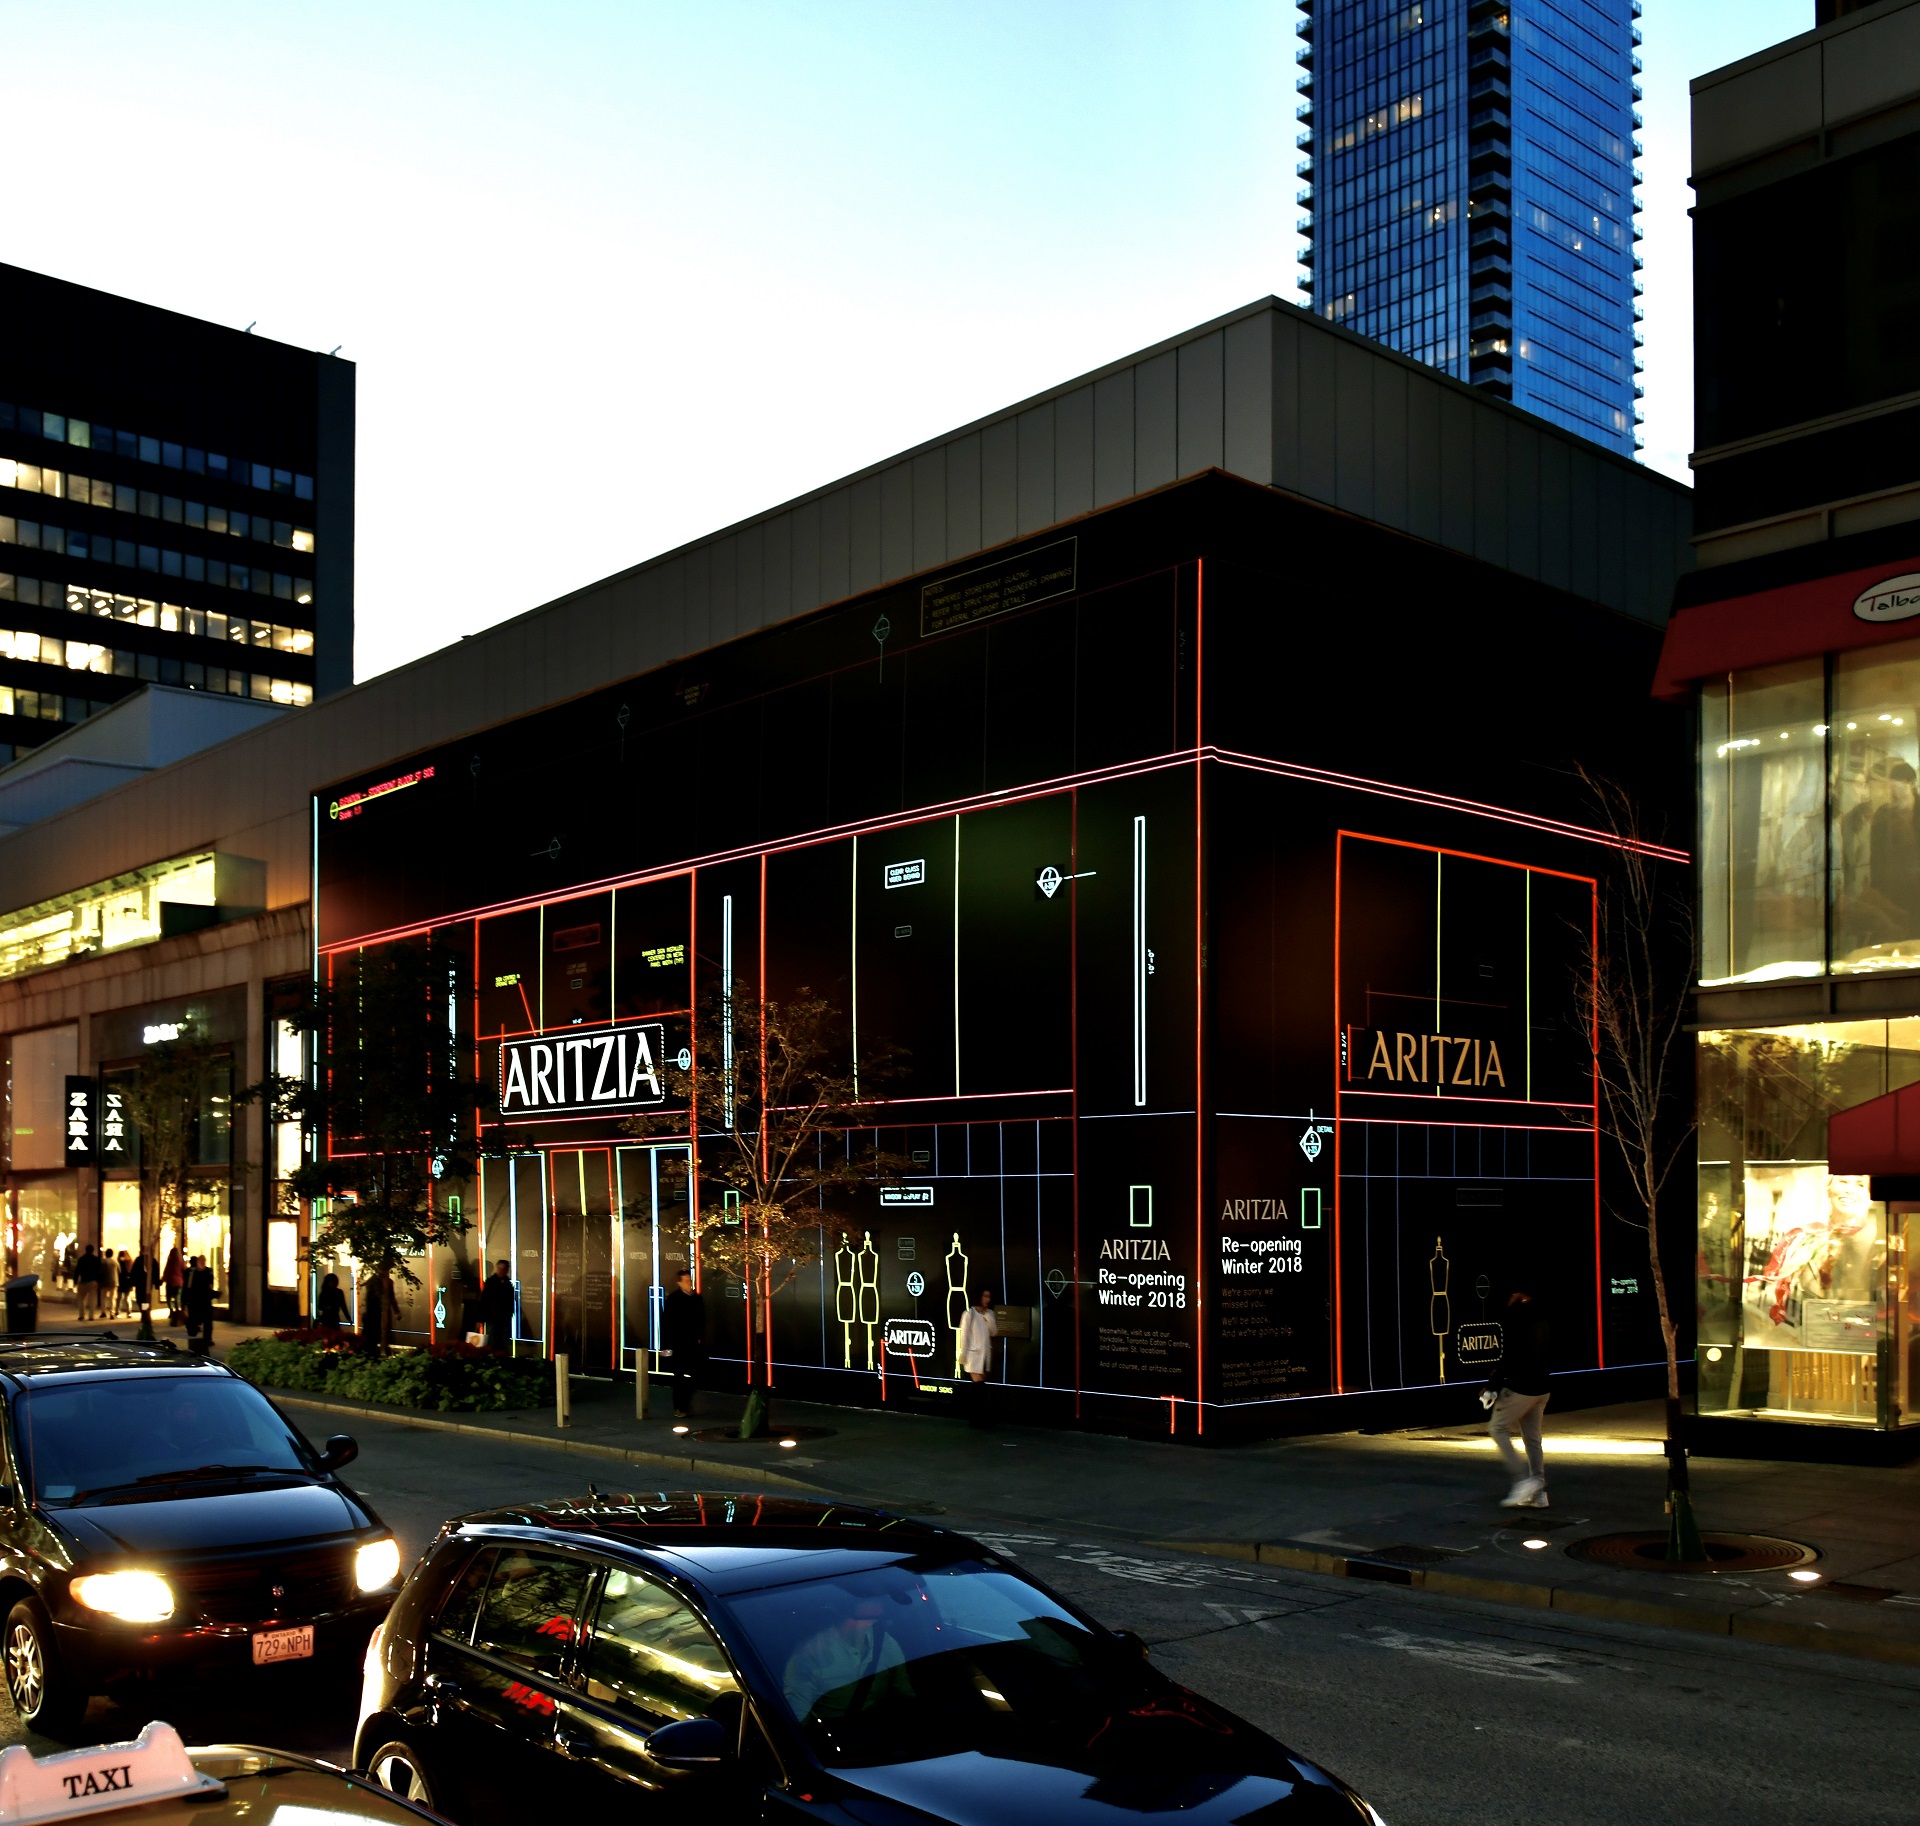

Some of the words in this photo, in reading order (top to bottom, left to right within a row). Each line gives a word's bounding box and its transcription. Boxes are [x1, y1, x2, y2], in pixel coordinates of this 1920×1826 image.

[1367, 1030, 1506, 1088] ARITZIA
[503, 1032, 661, 1108] ARITZIA
[68, 1092, 89, 1151] ZARA
[1221, 1199, 1288, 1220] ARITZIA
[1099, 1239, 1171, 1261] ARITZIA
[1222, 1236, 1302, 1256] Re-opening
[1221, 1258, 1265, 1274] Winter
[1268, 1256, 1303, 1273] 2018
[1098, 1268, 1186, 1291] Re-opening
[1098, 1289, 1143, 1306] Winter
[1147, 1291, 1186, 1309] 2018
[1243, 1288, 1263, 1298] sorry
[1264, 1288, 1275, 1296] we
[1221, 1299, 1249, 1309] missed
[889, 1329, 931, 1347] ARITZIA
[1126, 1336, 1149, 1345] Toronto
[1149, 1338, 1167, 1347] Eaton
[1461, 1334, 1500, 1352] ARITZIA
[1110, 1344, 1129, 1353] Queen
[1110, 1361, 1118, 1369] of
[1149, 1365, 1183, 1374] aritzia.com
[271, 1631, 297, 1639] ONTARIO
[256, 1638, 280, 1658] 729
[287, 1634, 311, 1653] NPH
[63, 1765, 133, 1799] TAXI
